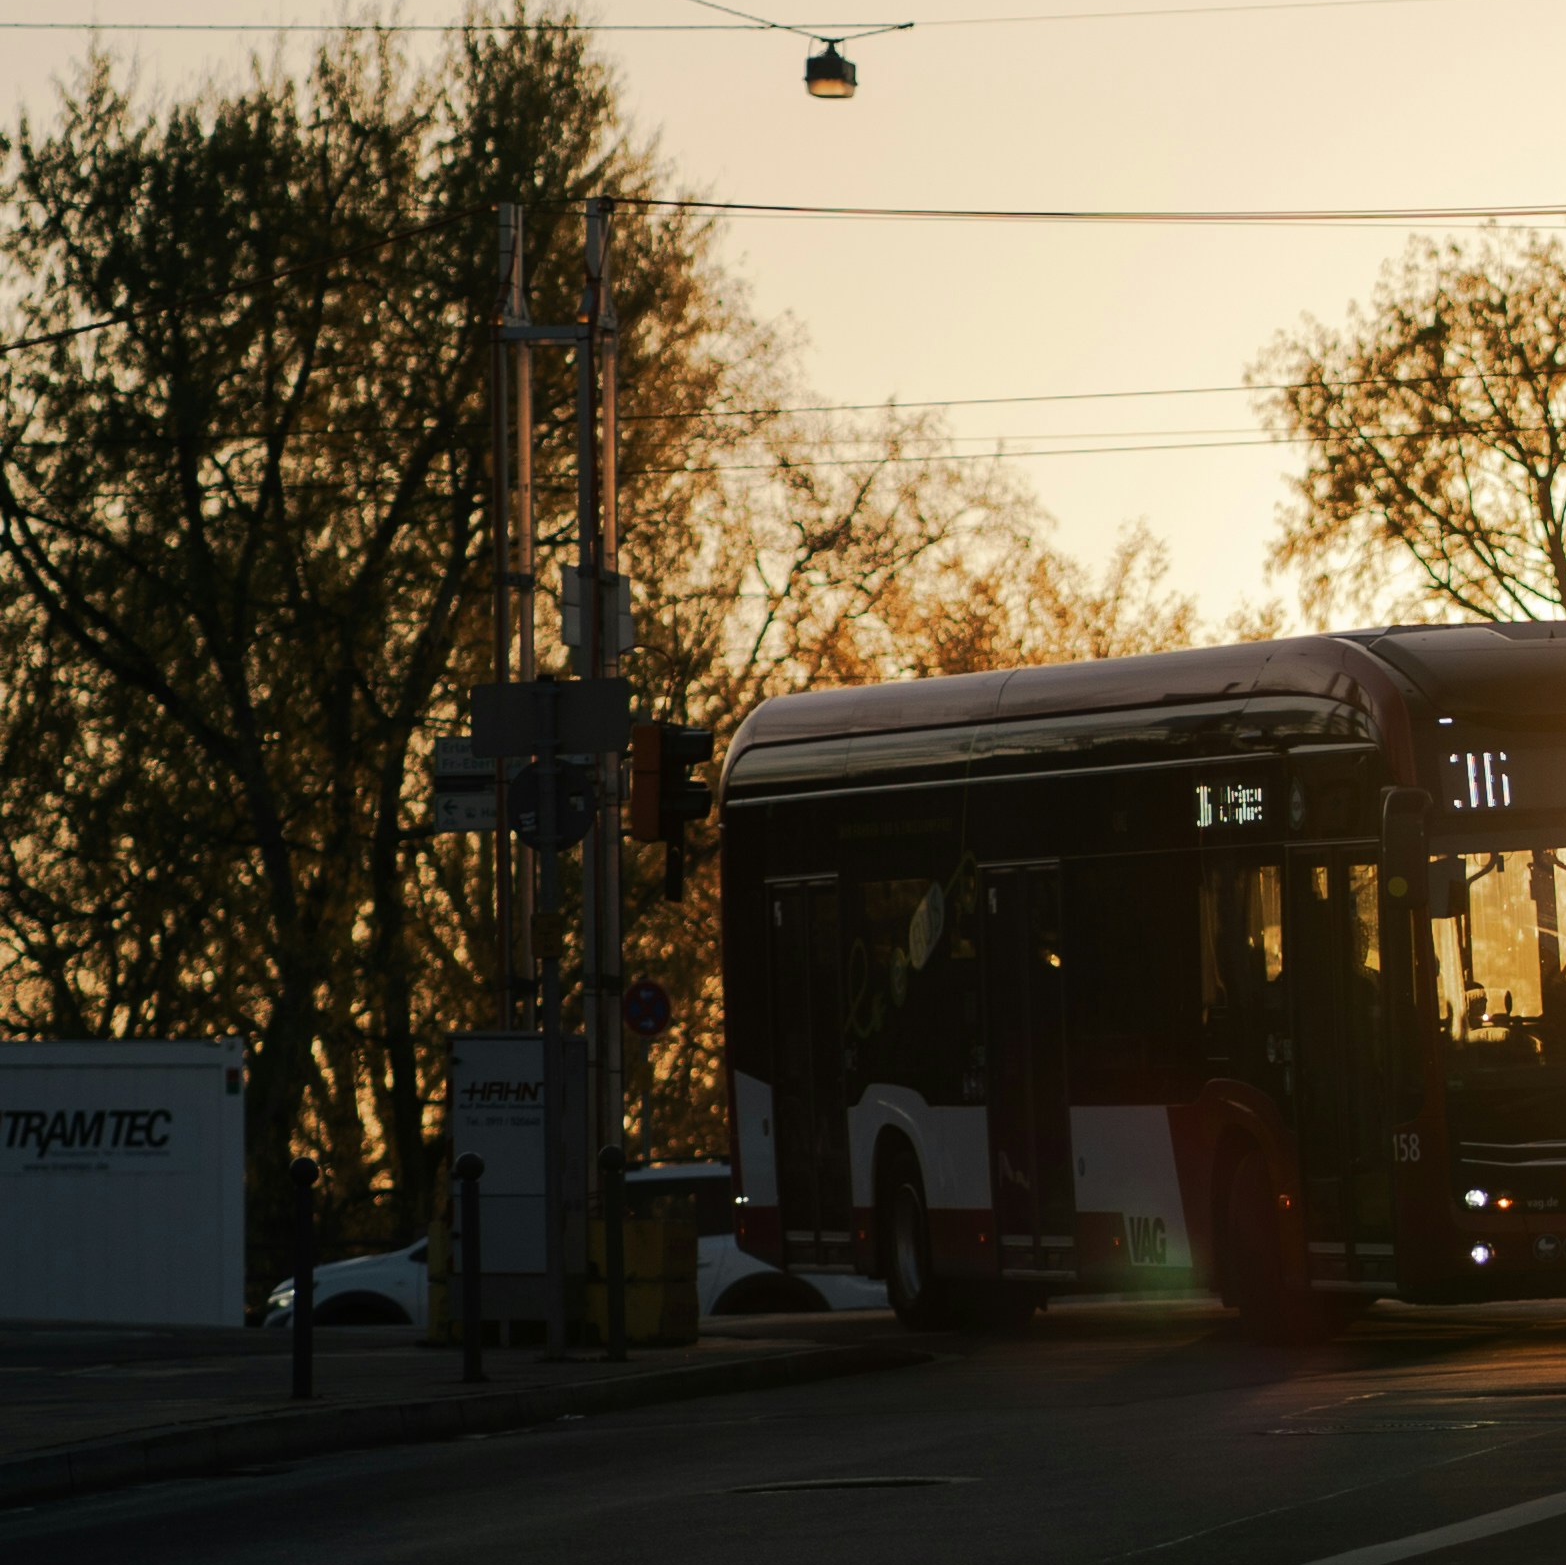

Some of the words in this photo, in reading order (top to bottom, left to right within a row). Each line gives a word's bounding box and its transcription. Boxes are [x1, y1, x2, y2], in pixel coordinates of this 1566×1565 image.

[1449, 751, 1511, 808] 36
[461, 1081, 543, 1102] HAHN
[1392, 1133, 1421, 1162] 158
[1527, 1196, 1559, 1210] vag.de
[1129, 1217, 1167, 1264] VAG
